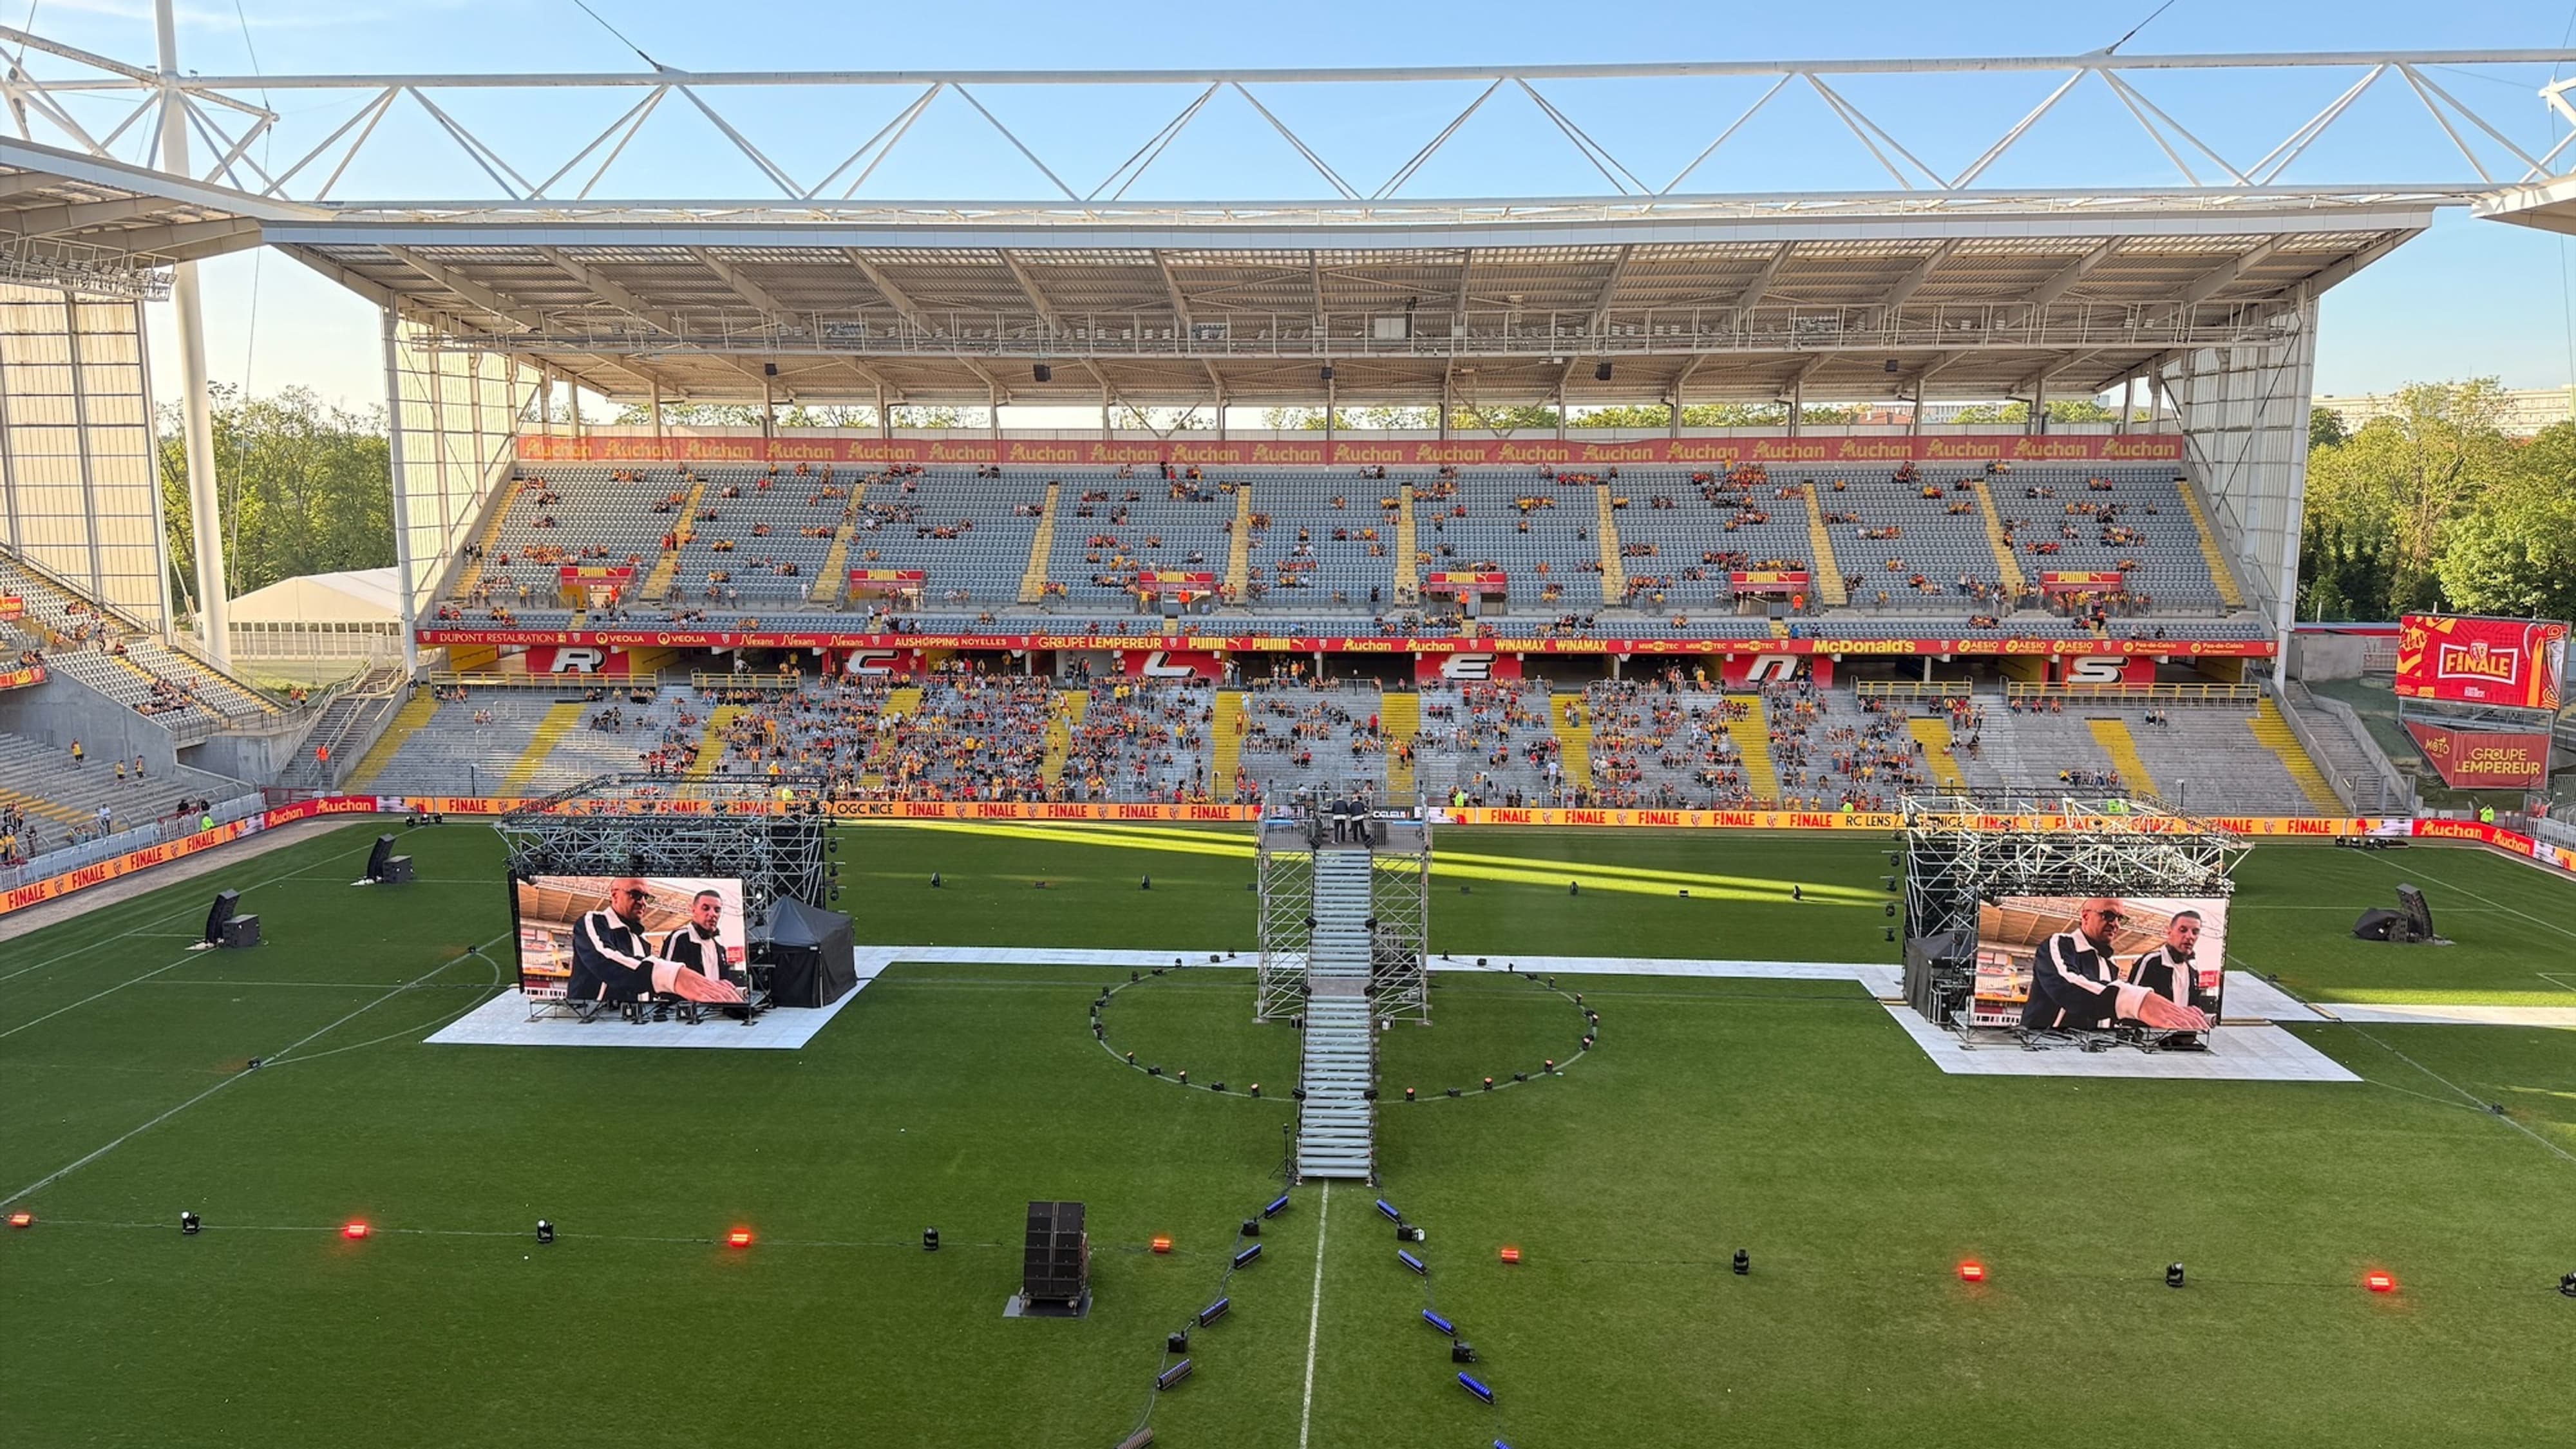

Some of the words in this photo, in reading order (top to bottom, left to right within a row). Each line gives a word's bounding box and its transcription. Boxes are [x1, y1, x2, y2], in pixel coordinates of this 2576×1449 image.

[525, 440, 592, 458] Auchan
[605, 440, 672, 458] Auchan
[685, 440, 753, 458] Auchan
[766, 440, 835, 459] Auchan
[848, 442, 915, 460] Auchan
[928, 442, 996, 460] Auchan
[1009, 443, 1077, 460] Auchan
[1090, 444, 1158, 462] Auchan
[1171, 444, 1239, 462] Auchan
[1252, 444, 1320, 462] Auchan
[1333, 444, 1402, 462] Auchan
[1416, 443, 1485, 461] Auchan
[1499, 443, 1568, 461] Auchan
[1582, 444, 1653, 462] Auchan
[1667, 442, 1738, 459] Auchan
[1752, 440, 1824, 459] Auchan
[1839, 440, 1912, 458] Auchan
[1926, 439, 2000, 457] Auchan
[2014, 439, 2088, 457] Auchan
[2101, 439, 2175, 456] Auchan
[439, 632, 483, 643] DUPONT
[486, 632, 554, 643] RESTAURATION
[608, 634, 644, 643] VEOLIA
[739, 634, 774, 645] Nexans
[781, 634, 816, 646] Nexans
[829, 635, 864, 647] Nexans
[894, 637, 958, 647] AUSHOPPING
[961, 638, 1006, 647] NOYELLES
[1037, 637, 1084, 649] GROUPE
[1090, 638, 1161, 649] LEMPEREUR
[1189, 639, 1225, 650] PUMA
[1253, 639, 1289, 650] PUMA
[1342, 639, 1391, 651] Auchan
[1405, 639, 1454, 652] Auchan
[1494, 640, 1545, 651] WINAMAX
[1555, 641, 1607, 652] WINAMAX
[1812, 640, 1916, 652] McDonald's
[552, 647, 606, 674] R
[1143, 650, 1197, 678] L
[2067, 656, 2130, 684] S
[2446, 653, 2509, 677] FINALE
[2471, 747, 2528, 760] GROUPE
[2455, 760, 2541, 775] LEMPEREUR
[316, 798, 372, 813] Auchan
[449, 800, 488, 813] FINALE
[837, 804, 866, 815] OGC
[869, 804, 894, 815] NICE
[905, 803, 945, 817] FINALE
[977, 804, 1017, 817] FINALE
[1048, 804, 1087, 818] FINALE
[1119, 804, 1159, 819] FINALE
[1191, 806, 1230, 819] FINALE
[269, 805, 303, 826] Auchan
[1491, 809, 1531, 824] FINALE
[1565, 810, 1605, 824] FINALE
[1638, 811, 1680, 825] FINALE
[1713, 812, 1756, 826] FINALE
[1790, 813, 1832, 828] FINALE
[1846, 815, 1861, 827] RC
[1866, 815, 1891, 827] LENS
[2287, 820, 2331, 833] FINALE
[2420, 820, 2482, 839] Auchan
[187, 830, 216, 851] FINALE
[2493, 828, 2530, 855] Auchan
[131, 847, 164, 869] FINALE
[72, 864, 106, 888] FINALE
[8, 883, 46, 908] FINALE
